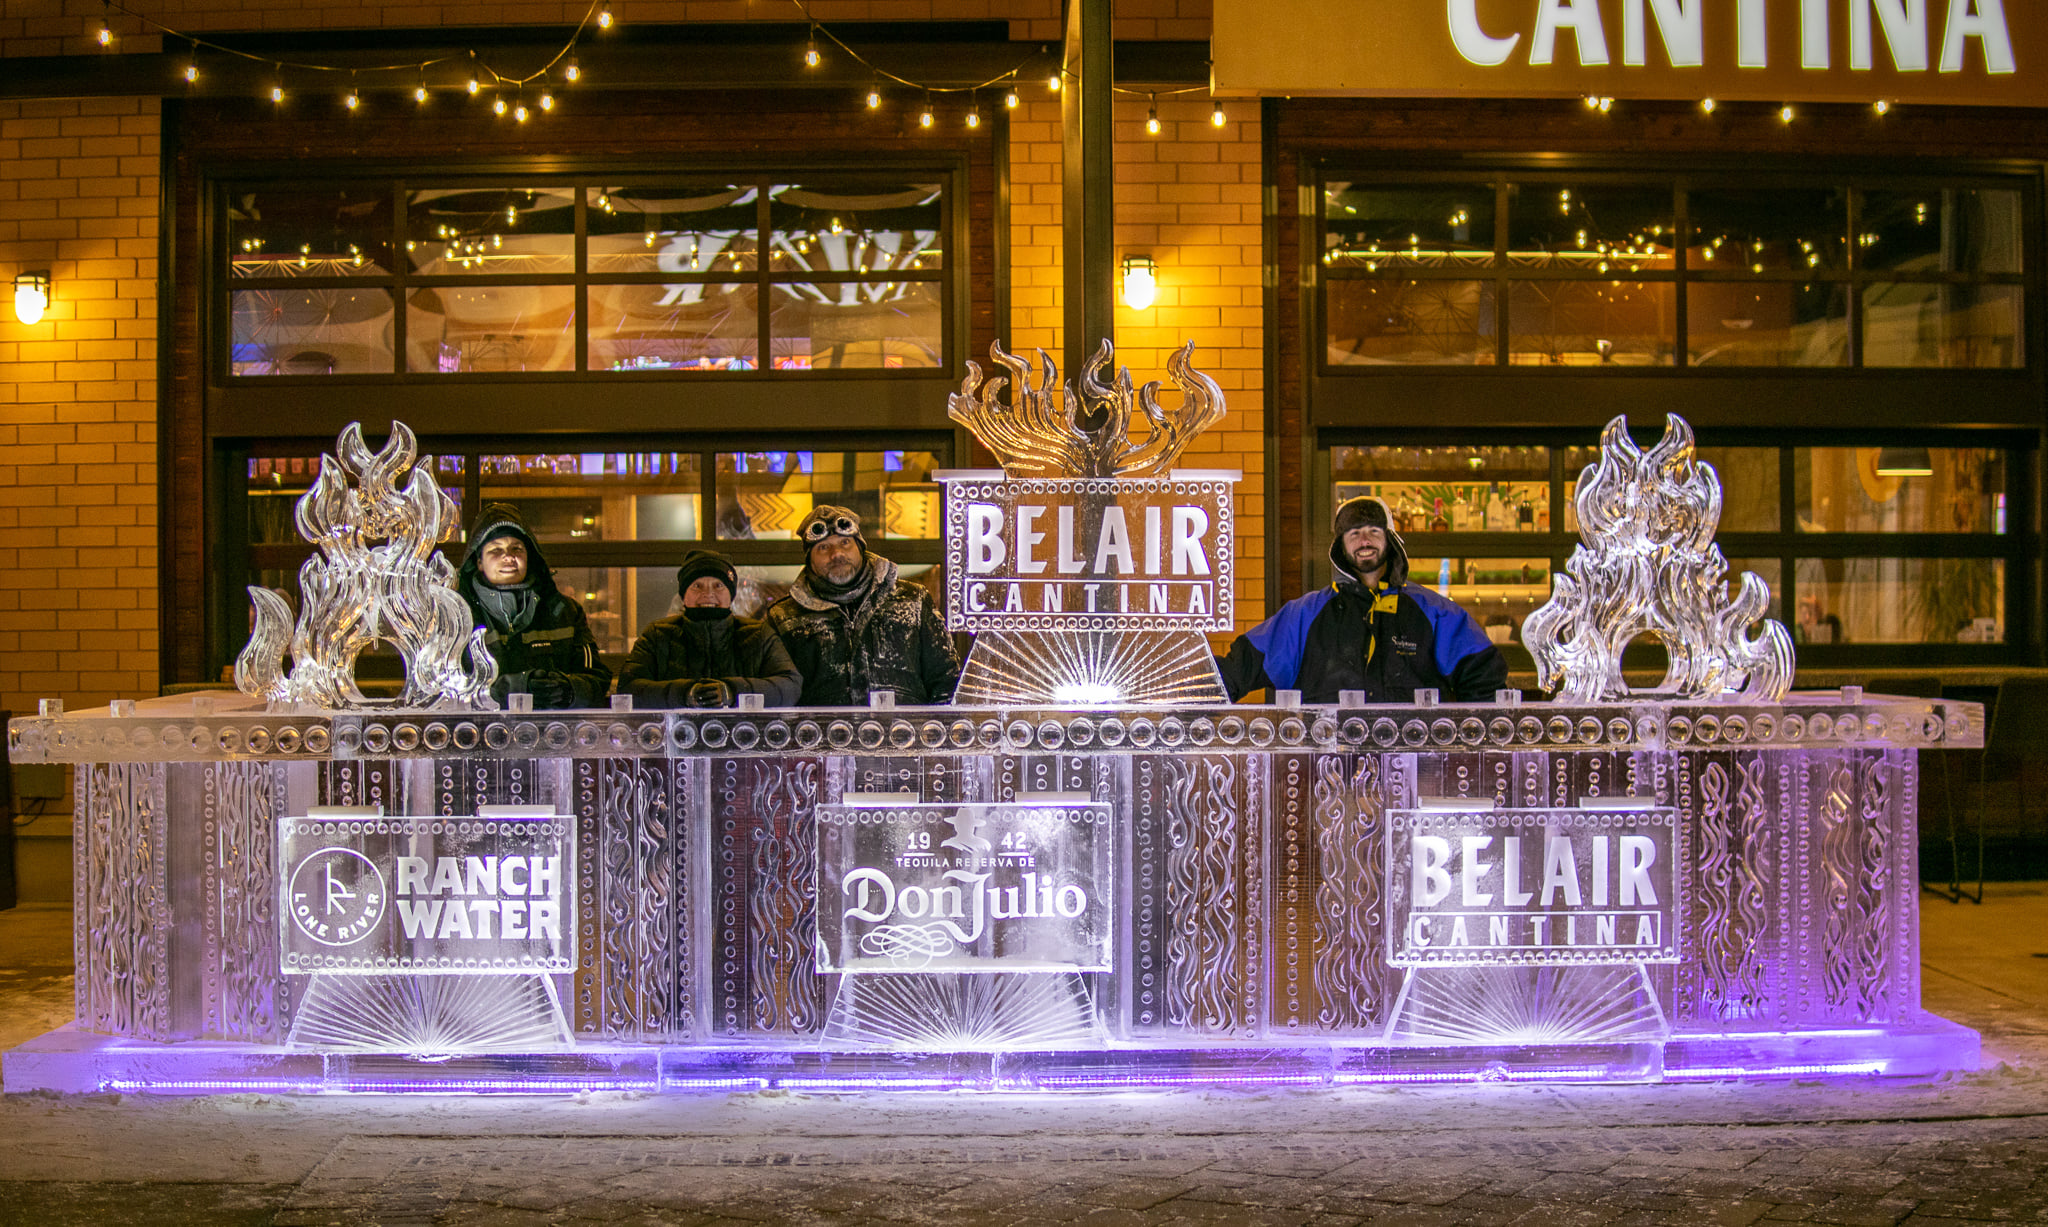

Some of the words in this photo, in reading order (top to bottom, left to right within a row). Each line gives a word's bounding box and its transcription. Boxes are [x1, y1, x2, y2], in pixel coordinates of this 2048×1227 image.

[967, 503, 1212, 576] BELAIR
[969, 583, 1207, 614] CANTINA
[907, 832, 931, 849] 19
[1001, 831, 1026, 849] 42
[396, 855, 561, 896] RANCH
[896, 857, 950, 868] TEQUILA
[956, 857, 1013, 868] RESERVA
[1019, 857, 1035, 868] DE
[1412, 835, 1658, 907] BELAIR
[294, 893, 329, 938] LONE
[338, 892, 379, 940] RIVER
[396, 900, 562, 940] WATER
[1413, 915, 1654, 946] CANTINA
